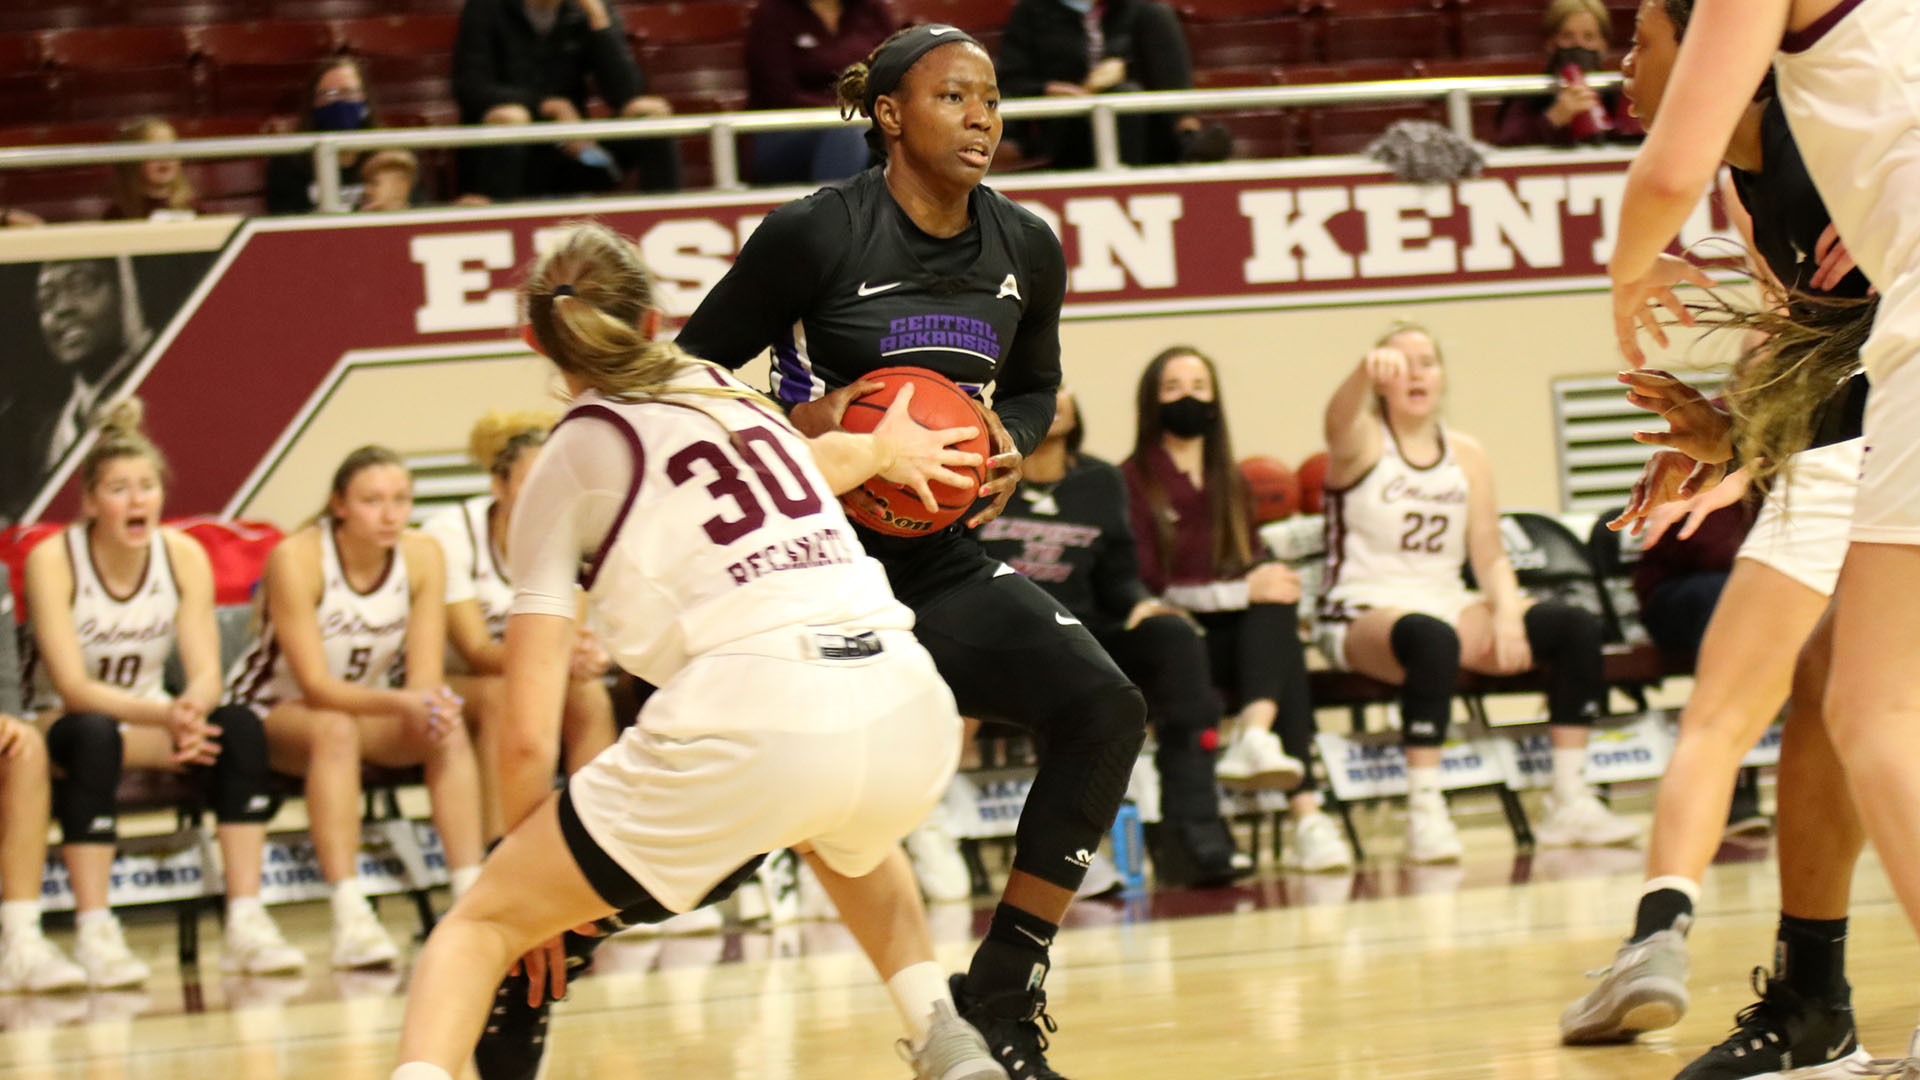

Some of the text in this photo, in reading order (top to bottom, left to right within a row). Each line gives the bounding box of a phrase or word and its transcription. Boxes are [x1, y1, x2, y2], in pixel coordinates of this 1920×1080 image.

[889, 313, 997, 341] CENTRAL
[879, 331, 1001, 359] ARKANSAS
[666, 425, 823, 546] 30
[1400, 511, 1449, 554] 22
[98, 653, 142, 688] 10
[344, 646, 372, 682] 5
